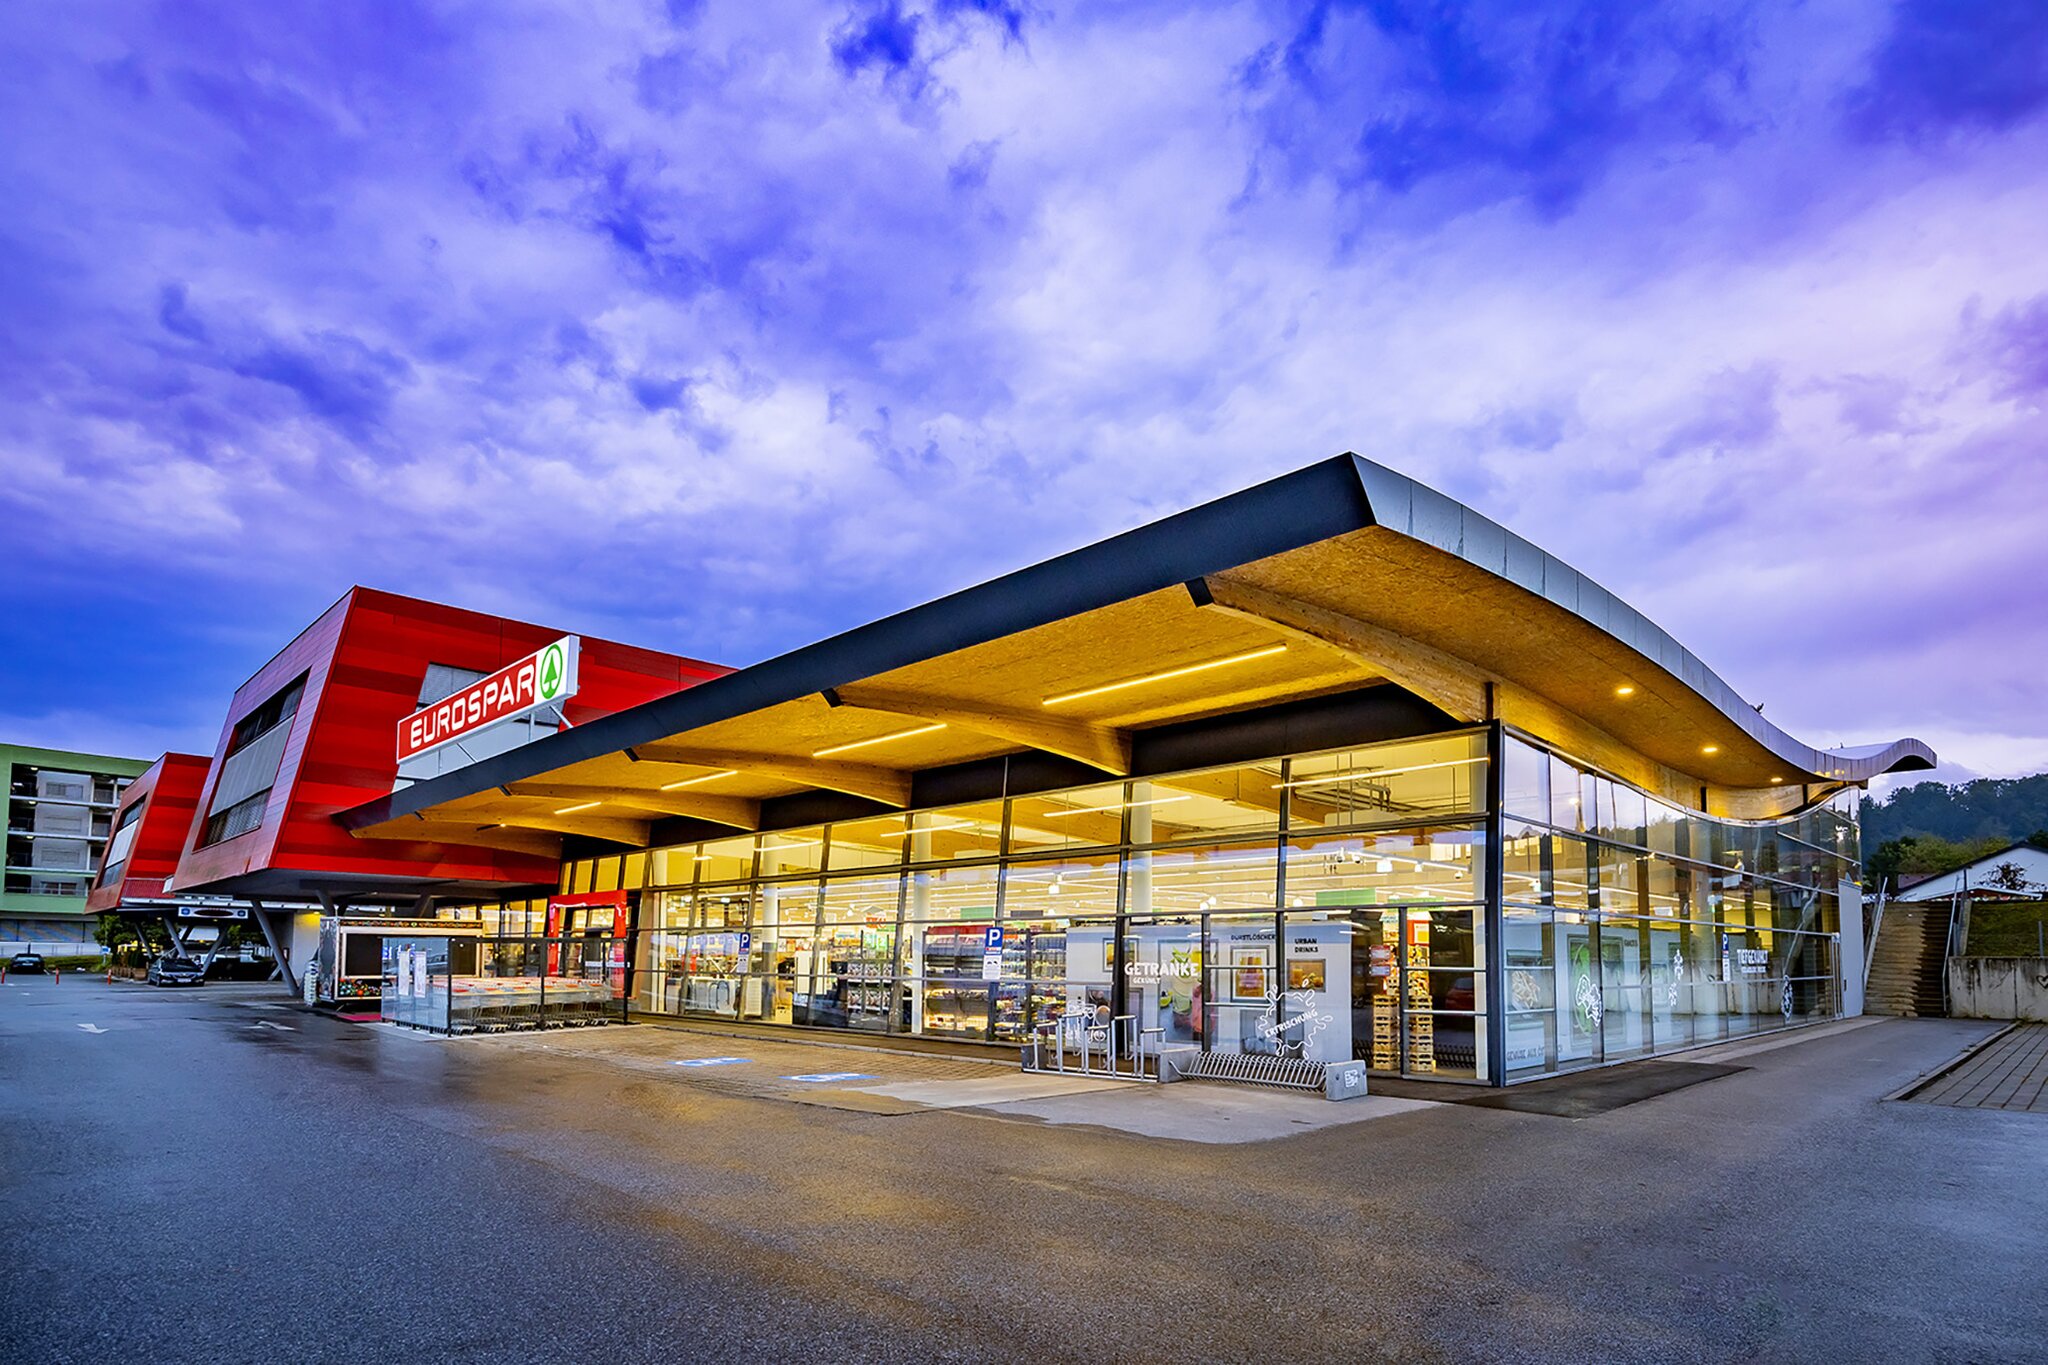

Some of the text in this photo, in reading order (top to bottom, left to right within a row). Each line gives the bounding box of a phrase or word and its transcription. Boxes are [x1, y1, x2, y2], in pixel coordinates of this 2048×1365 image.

[410, 663, 535, 749] EUROSPAR
[741, 933, 749, 948] P
[988, 928, 1001, 946] P
[1722, 933, 1729, 950] P
[1124, 960, 1200, 977] GETRÄNKE
[1264, 1008, 1318, 1038] ERFRISCHUNG
